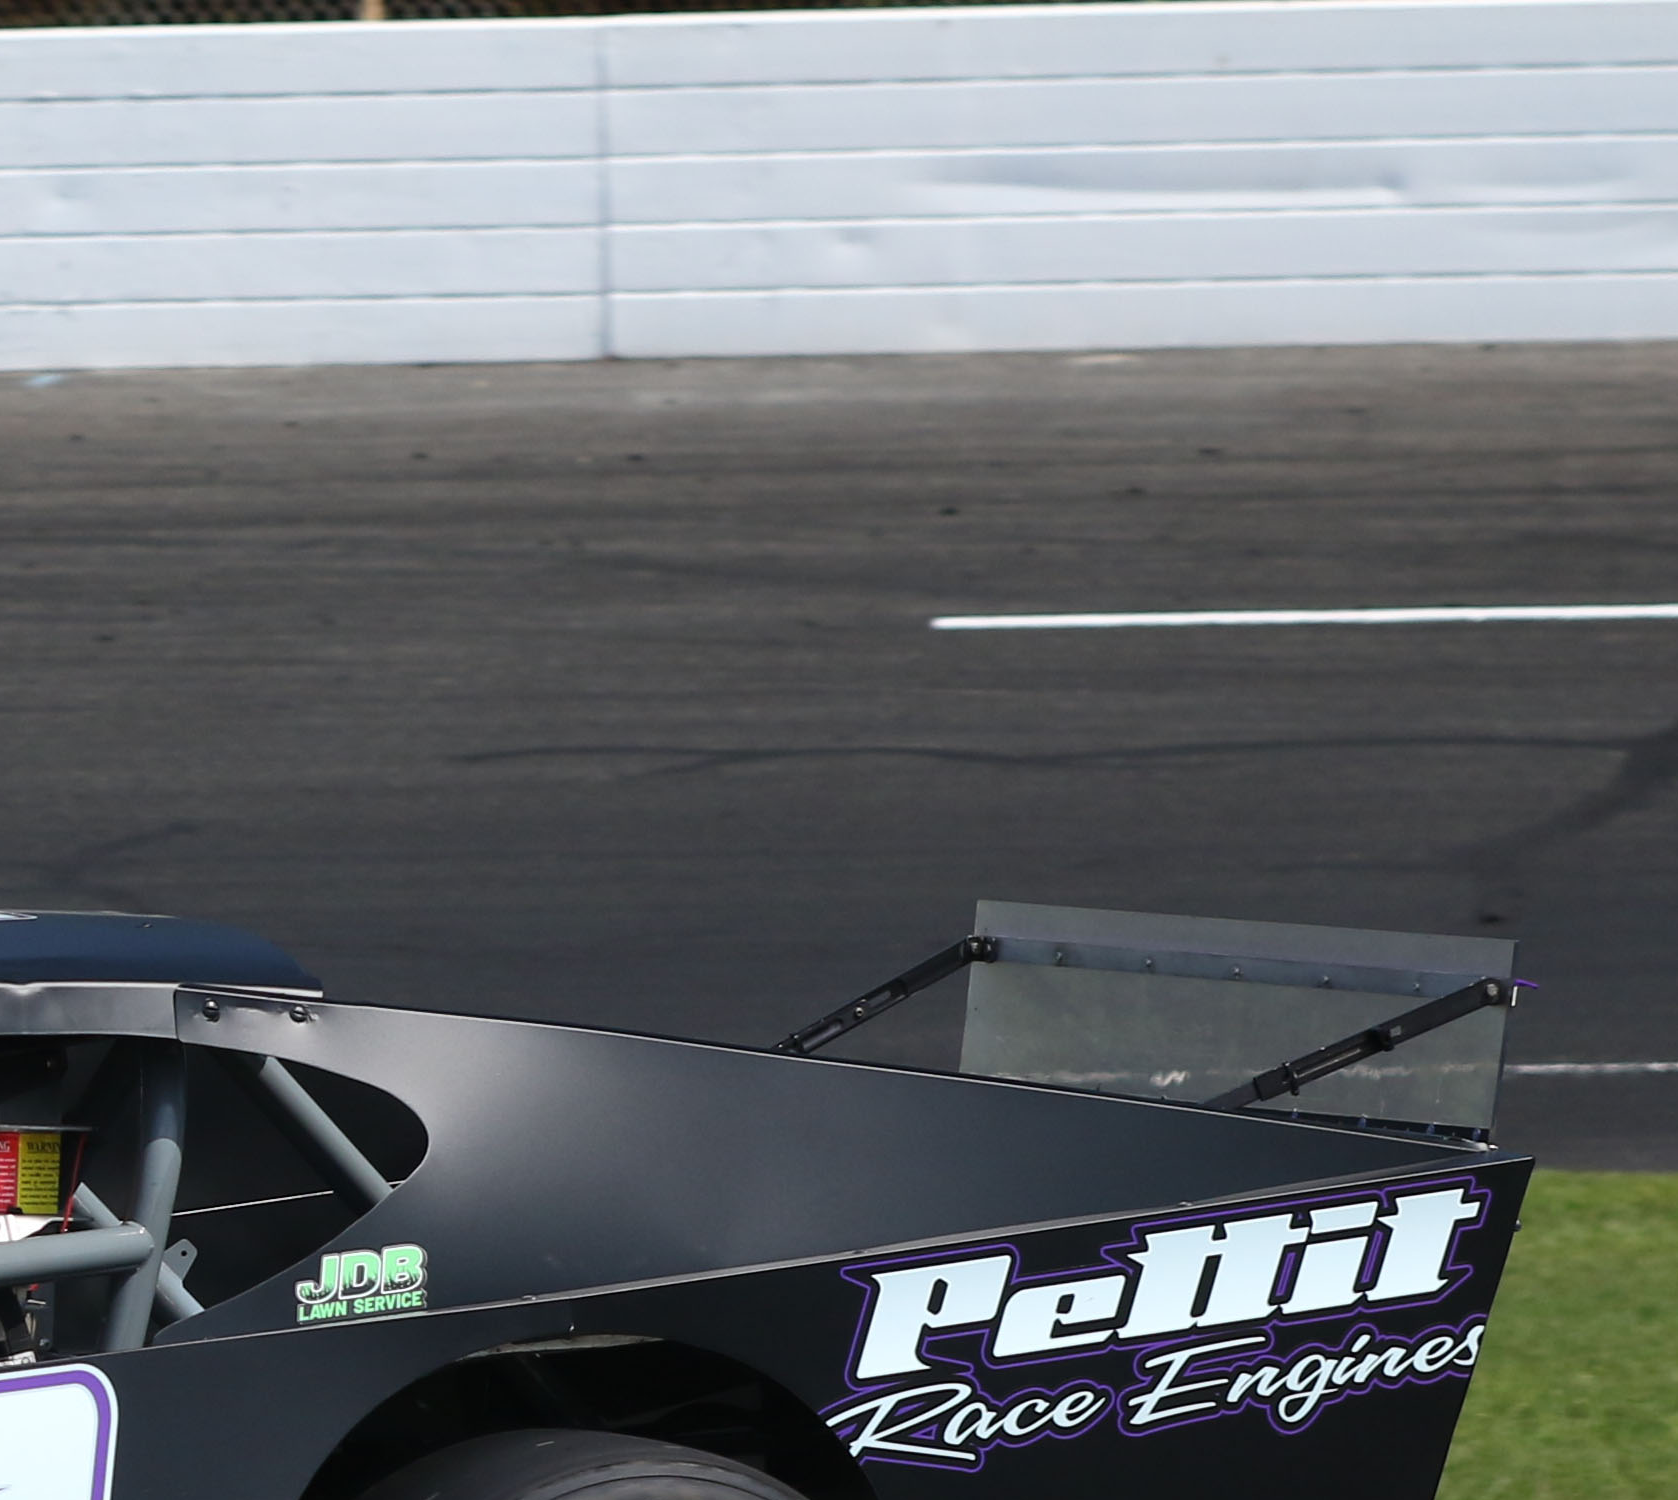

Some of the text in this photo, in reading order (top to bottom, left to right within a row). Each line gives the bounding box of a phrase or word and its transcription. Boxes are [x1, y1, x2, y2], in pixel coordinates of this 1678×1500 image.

[296, 1244, 425, 1304] JDB
[298, 1290, 423, 1322] LAWN SERVICE
[856, 1187, 1481, 1381] Pettit
[827, 1322, 1486, 1460] Race Engines
